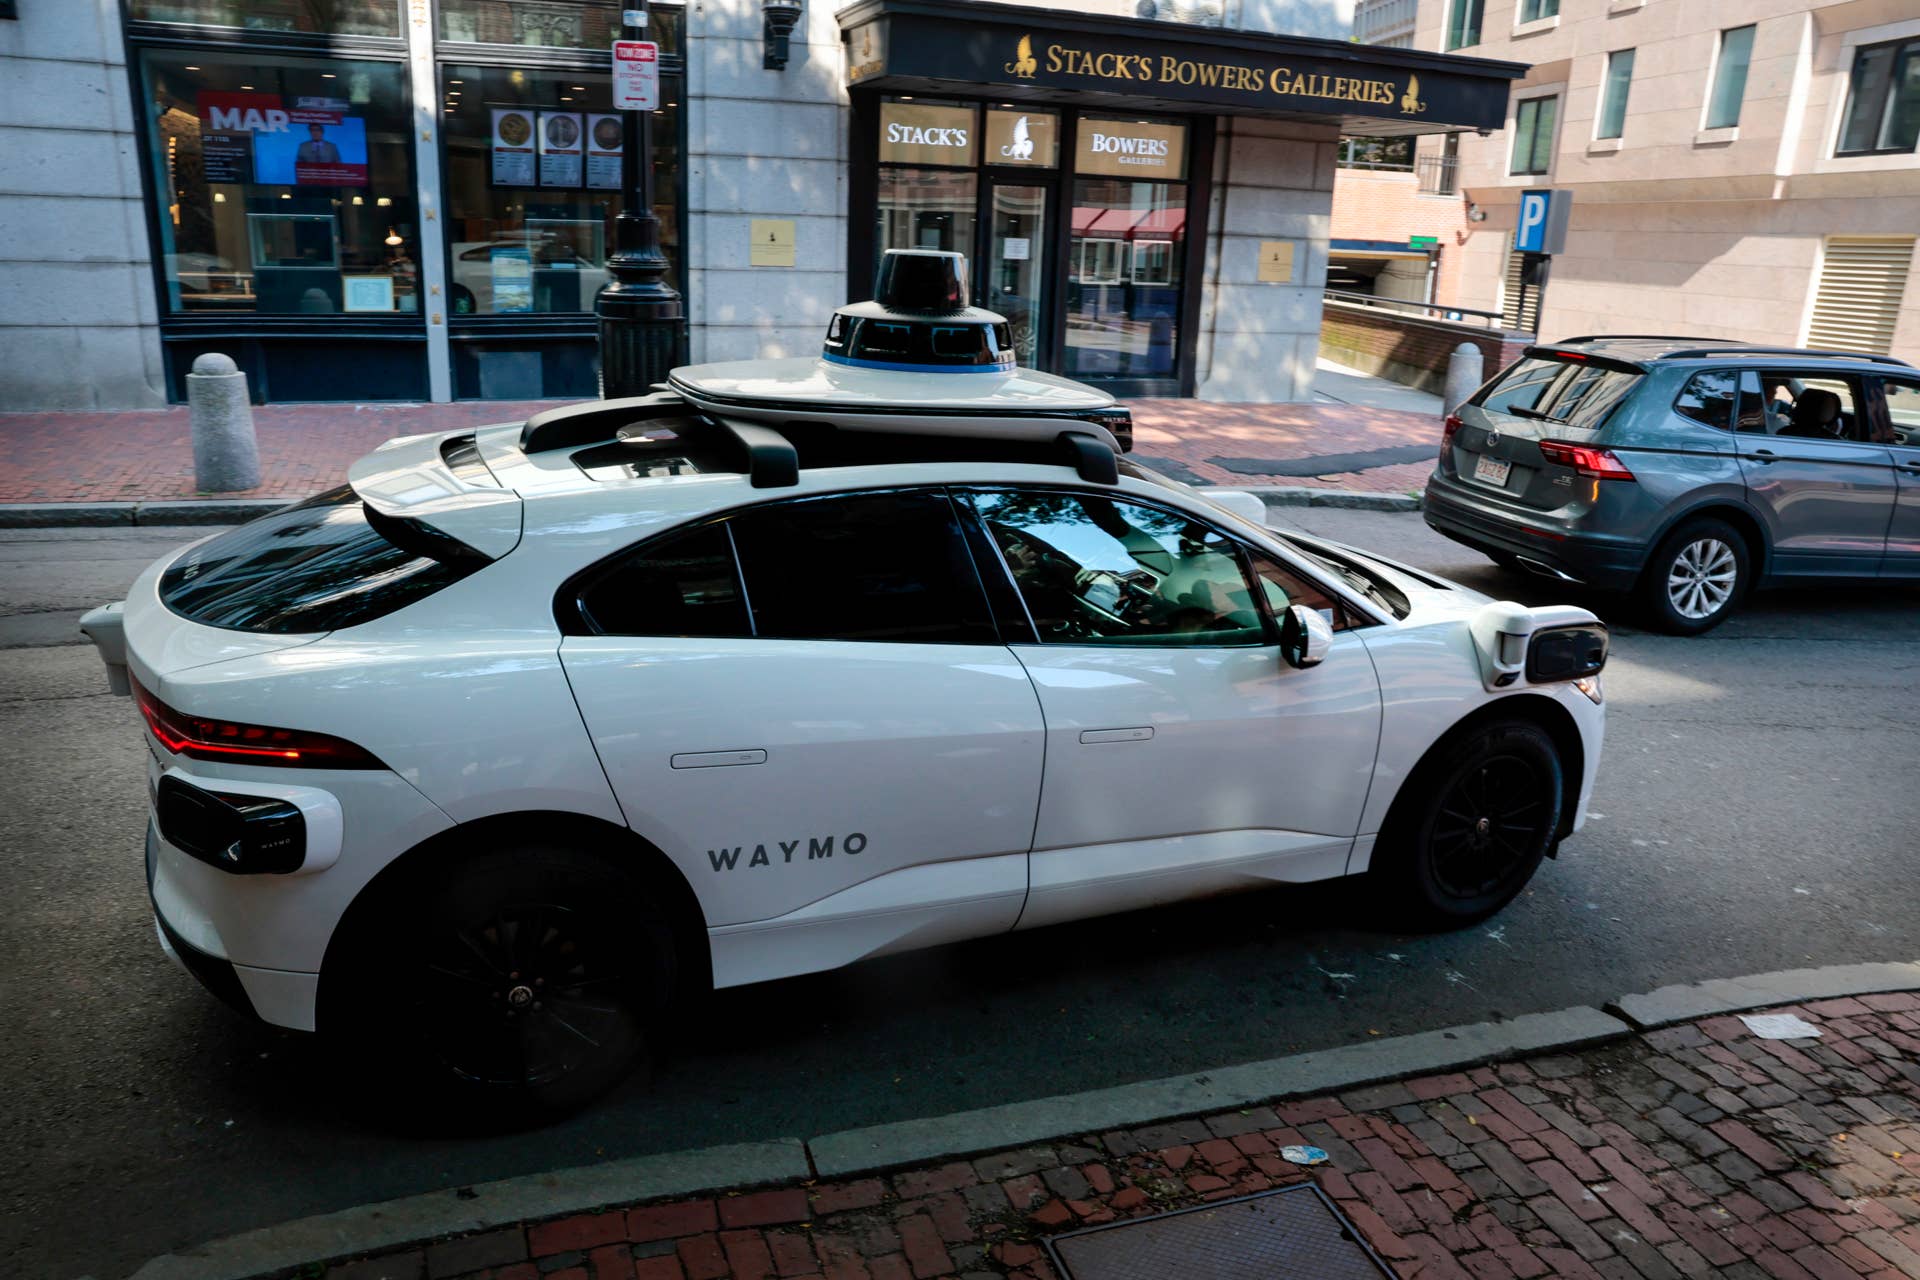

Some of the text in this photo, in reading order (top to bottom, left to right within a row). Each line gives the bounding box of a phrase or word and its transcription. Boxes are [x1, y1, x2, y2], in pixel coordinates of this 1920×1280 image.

[1046, 44, 1396, 105] STACK'S BOWERS GALLERIES
[208, 105, 291, 133] MAR
[887, 123, 967, 147] STACK'S
[1091, 133, 1169, 156] BOWERS
[1518, 195, 1546, 247] P
[261, 838, 291, 849] WAYMO
[707, 832, 868, 873] WAYMO
